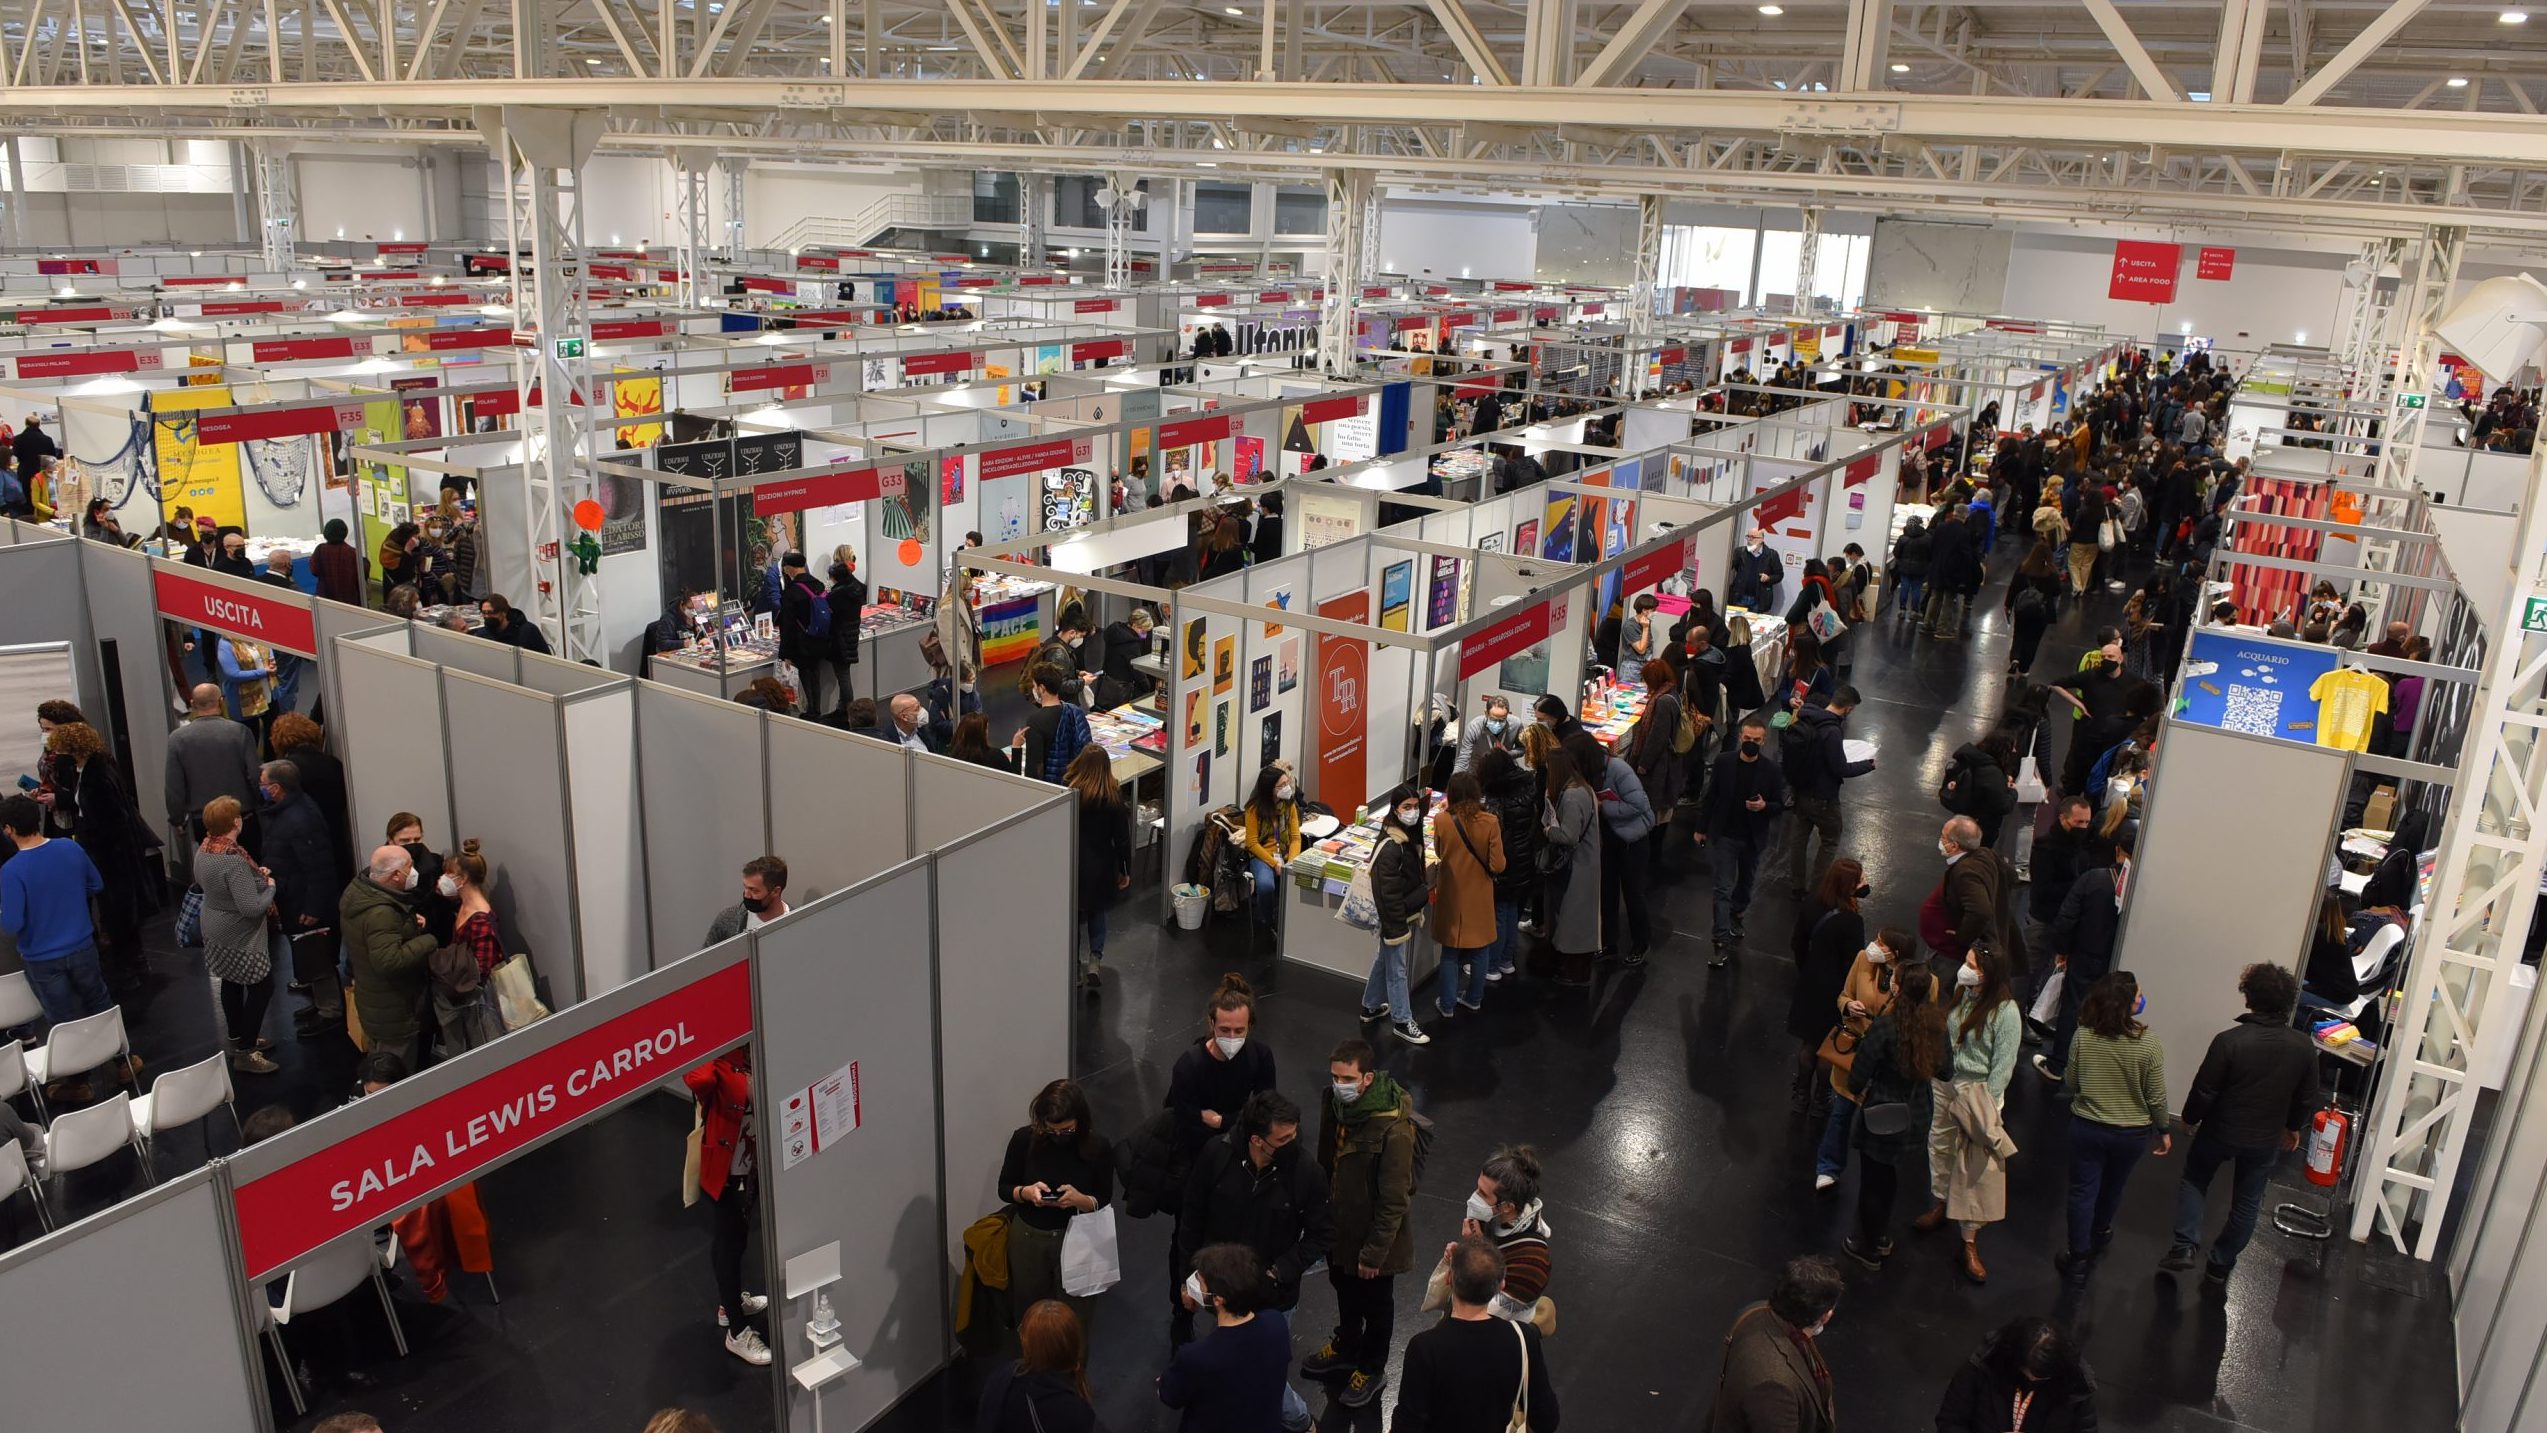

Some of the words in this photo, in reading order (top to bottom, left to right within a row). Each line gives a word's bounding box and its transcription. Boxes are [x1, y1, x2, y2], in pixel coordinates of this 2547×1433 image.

[2131, 260, 2156, 268] USCITA
[2128, 276, 2148, 284] AREA
[2149, 277, 2171, 285] FOOD
[354, 342, 370, 350] E33
[139, 355, 160, 365] E35
[973, 356, 985, 366] F27
[816, 369, 829, 378] F31
[340, 411, 362, 423] F35
[201, 424, 232, 432] MESOGEA
[1230, 419, 1244, 431] G29
[1076, 445, 1090, 457] G31
[881, 474, 902, 488] G33
[757, 490, 783, 500] EDIZIONI
[783, 487, 807, 497] HYPNOS
[204, 595, 264, 630] USCITA
[1551, 603, 1567, 623] H35
[990, 616, 1027, 639] PACE
[1488, 628, 1515, 646] TERRAROSSA
[1514, 619, 1532, 634] EDIZIONI
[2237, 650, 2289, 665] ACQUARIO
[330, 1143, 435, 1213] SALA
[446, 1083, 557, 1157] LEWIS
[566, 1021, 695, 1097] CARROL
